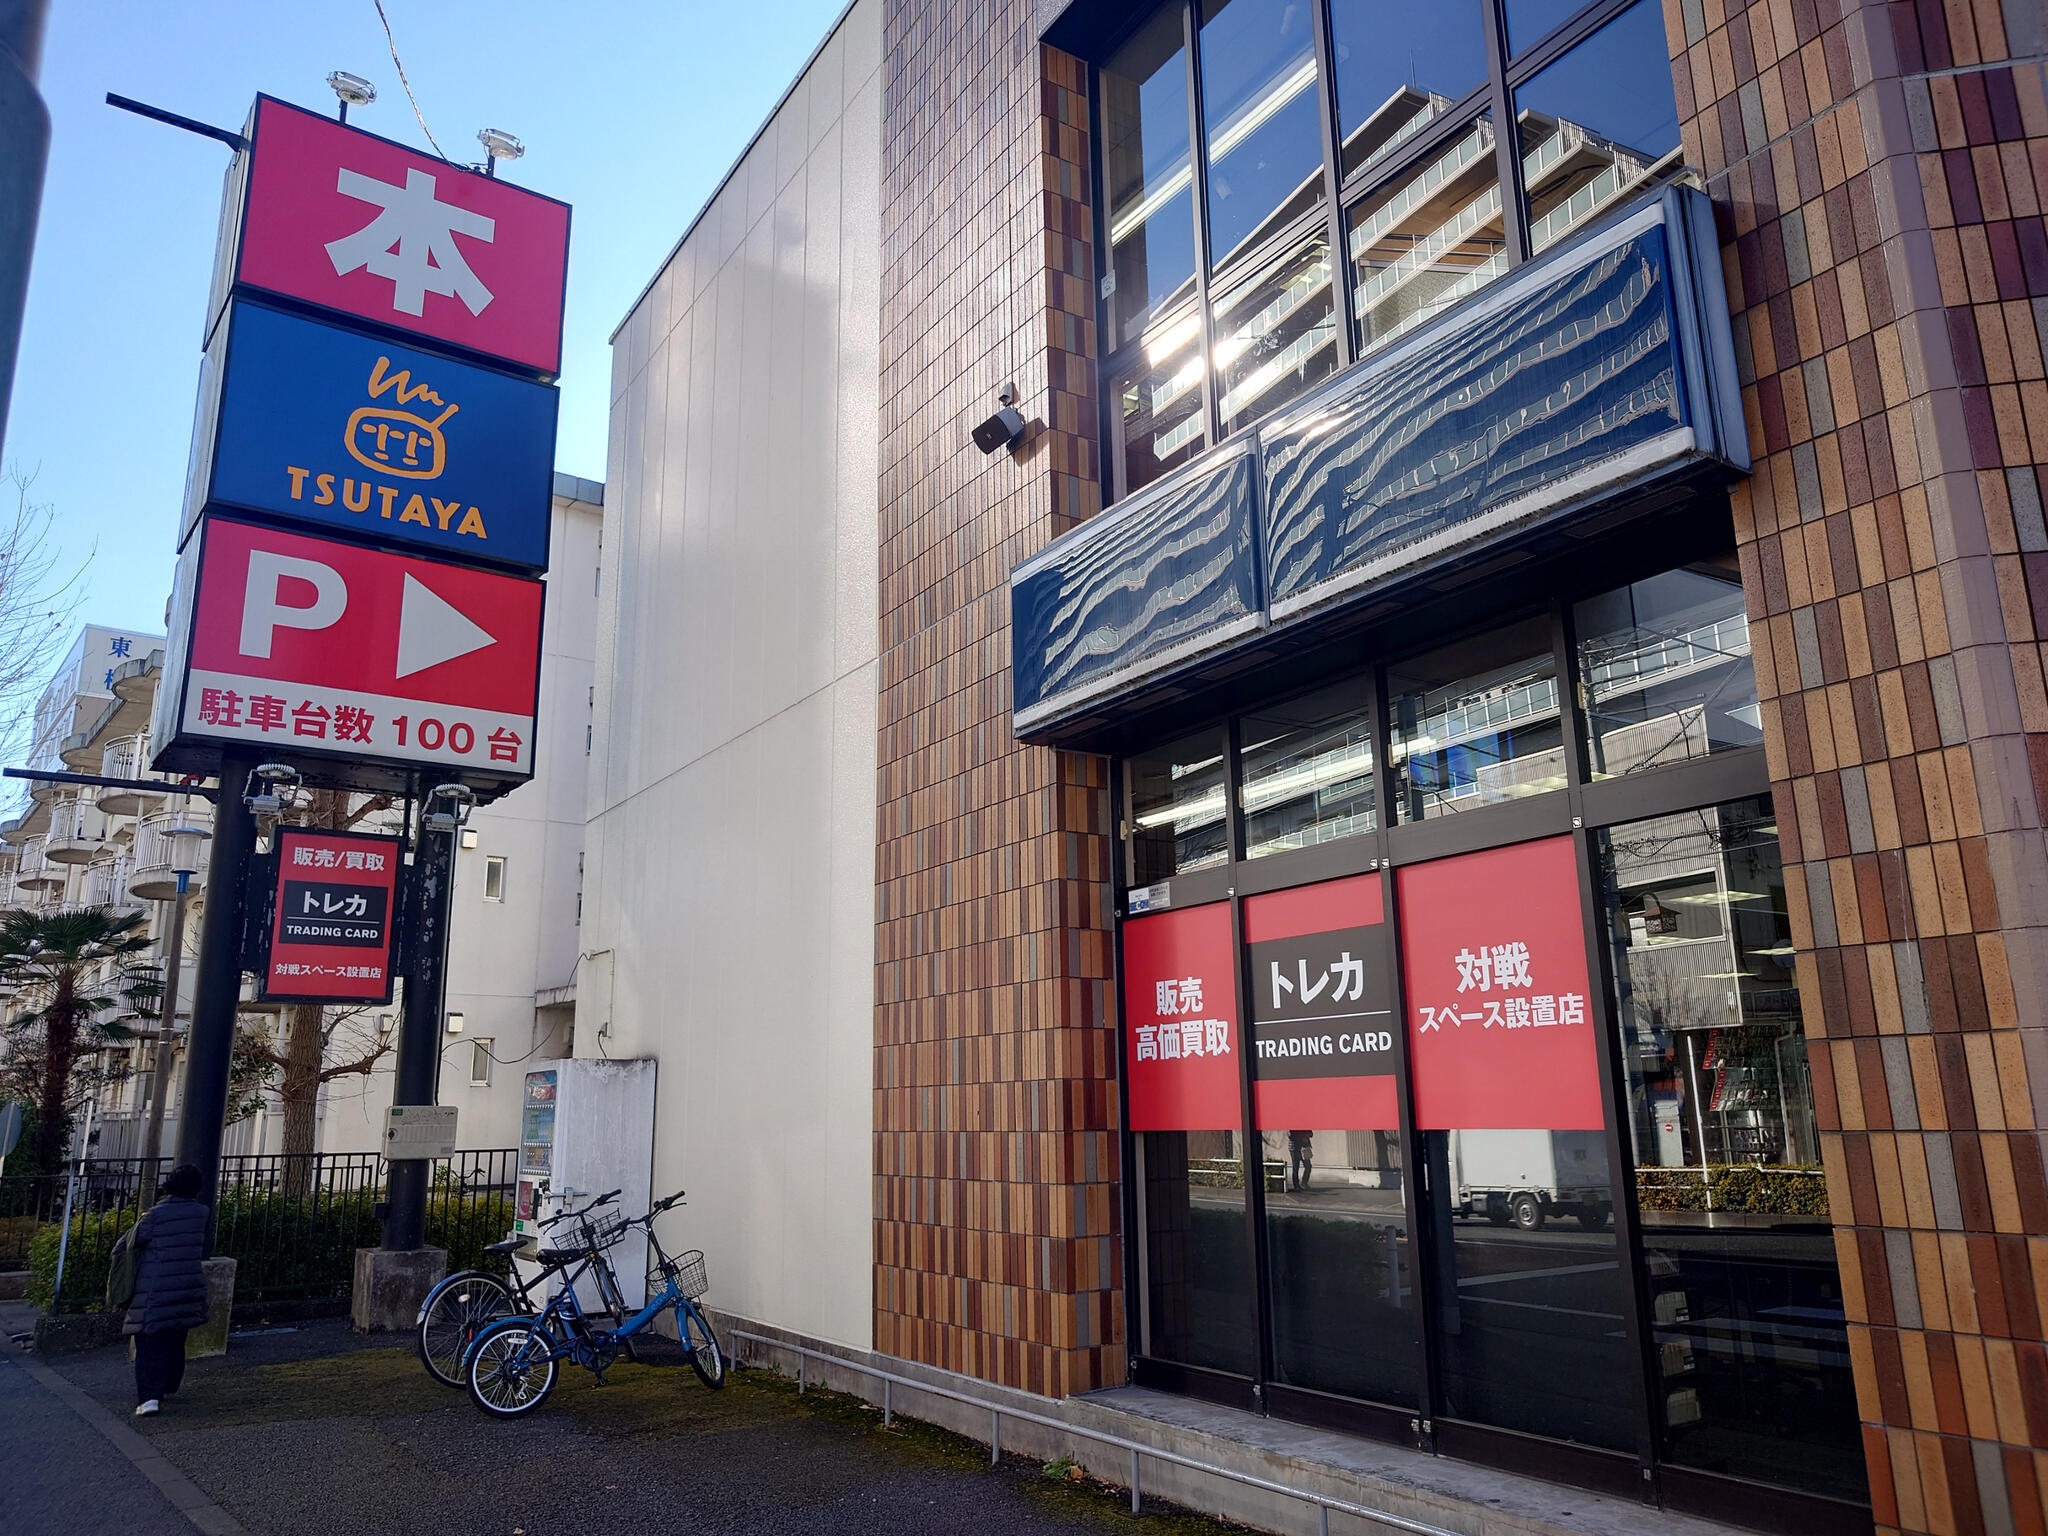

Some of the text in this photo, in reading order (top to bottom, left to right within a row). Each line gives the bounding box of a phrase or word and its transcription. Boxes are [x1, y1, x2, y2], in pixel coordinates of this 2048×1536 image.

[324, 167, 495, 318] 本
[287, 466, 488, 540] TSUTAYA
[239, 549, 348, 659] P
[198, 687, 523, 764] 駐車台数 100 台
[292, 846, 385, 872] 販売/買取
[303, 890, 367, 917] トレカ
[286, 925, 379, 939] TRADING CARD
[274, 962, 382, 979] 対戦スペース設置店
[1271, 951, 1364, 1009] トレカ
[1455, 941, 1533, 994] 対戦
[1155, 976, 1204, 1017] 販売
[1419, 992, 1585, 1034] スペース設置店
[1135, 1018, 1231, 1062] 高価買取
[1255, 1031, 1393, 1059] TRADING CARD
